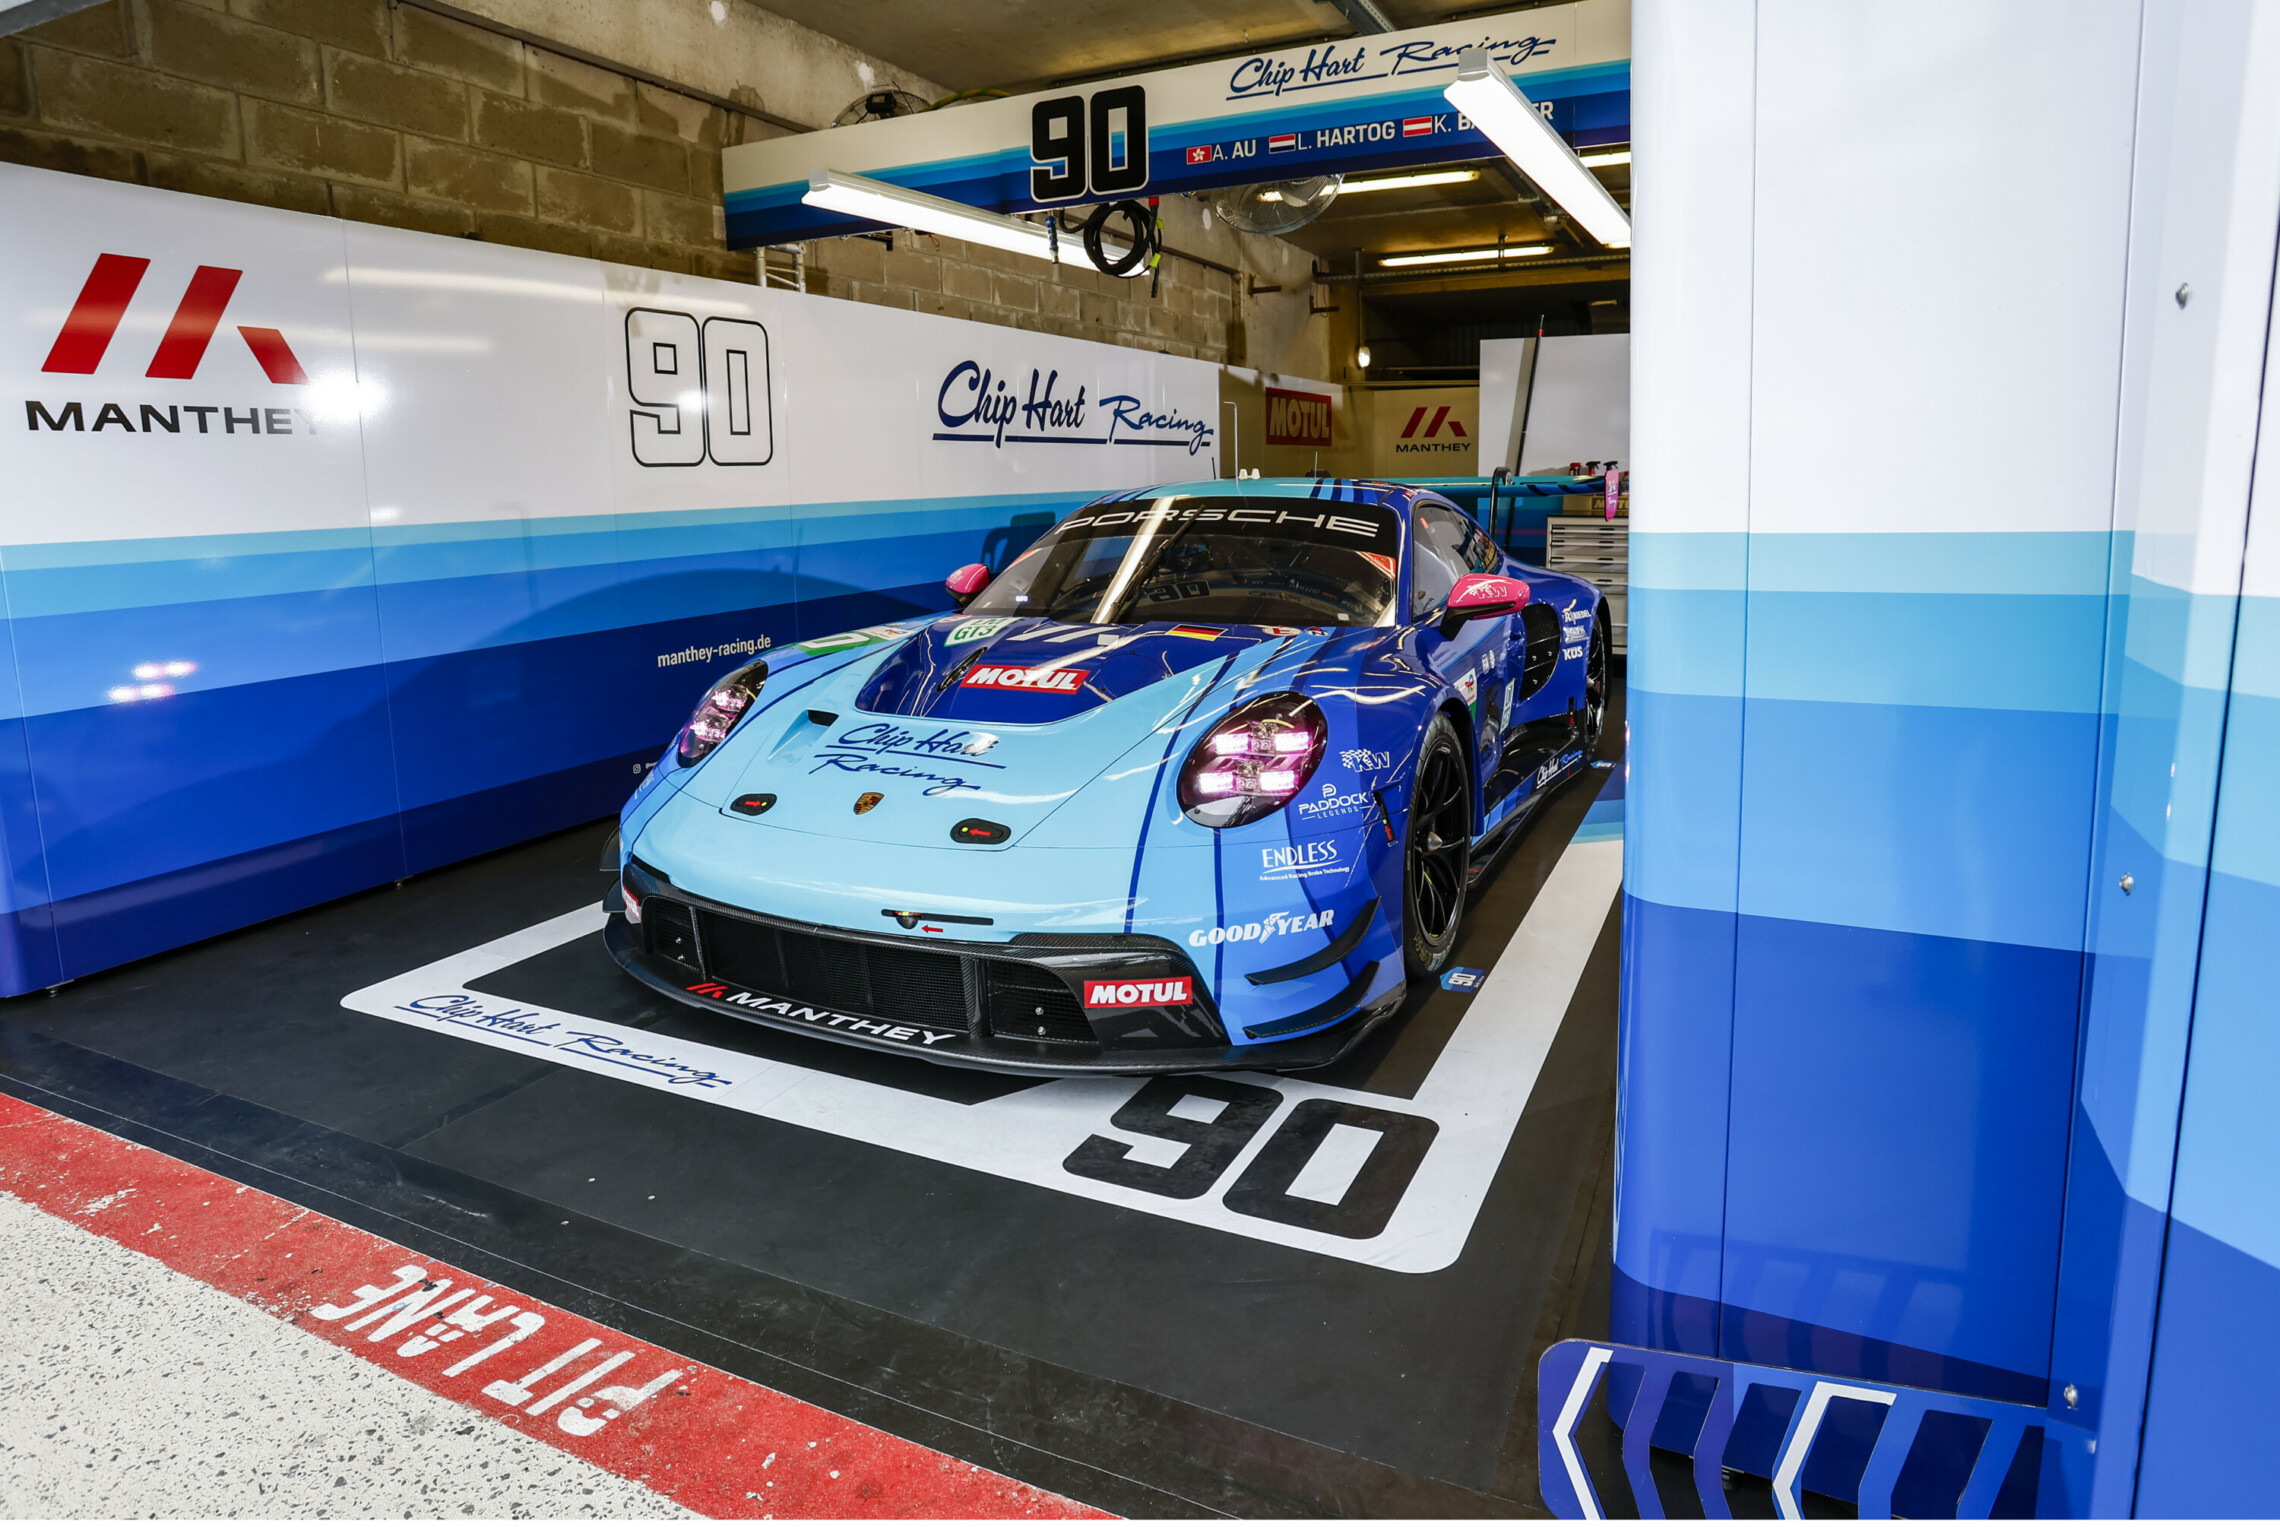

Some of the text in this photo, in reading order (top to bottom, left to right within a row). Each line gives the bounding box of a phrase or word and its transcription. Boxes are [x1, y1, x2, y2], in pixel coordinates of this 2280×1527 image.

[1230, 58, 1294, 96] Chip
[1299, 45, 1366, 81] Hart
[1030, 85, 1149, 203] 90
[1212, 144, 1228, 161] A.
[1232, 139, 1257, 159] AU
[1298, 133, 1312, 150] L.
[1317, 121, 1396, 148] HARTOG
[1434, 114, 1451, 133] K.
[625, 306, 773, 467] 90
[938, 360, 1214, 455] Chip Hart Racing
[1269, 397, 1330, 439] MOTUL
[1396, 443, 1471, 453] MANTHEY
[1054, 509, 1379, 537] PORSCHE
[657, 634, 771, 668] manthey-racing.de
[954, 625, 997, 640] GT3
[966, 667, 1078, 690] MOTUL
[838, 723, 914, 754] Chip
[808, 754, 981, 796] Racing
[1299, 792, 1369, 814] PADDOCK
[1316, 806, 1359, 819] LEGENDS
[1262, 839, 1337, 868] ENDLESS
[1259, 873, 1288, 881] Advanced
[1307, 869, 1323, 877] Brake
[1323, 866, 1350, 875] Technology
[1089, 981, 1188, 1004] MOTUL
[726, 992, 956, 1045] MANTHEY
[409, 995, 732, 1084] Chip Hart Racing
[1062, 1074, 1440, 1240] 90
[310, 1264, 684, 1437] PIT LANE
